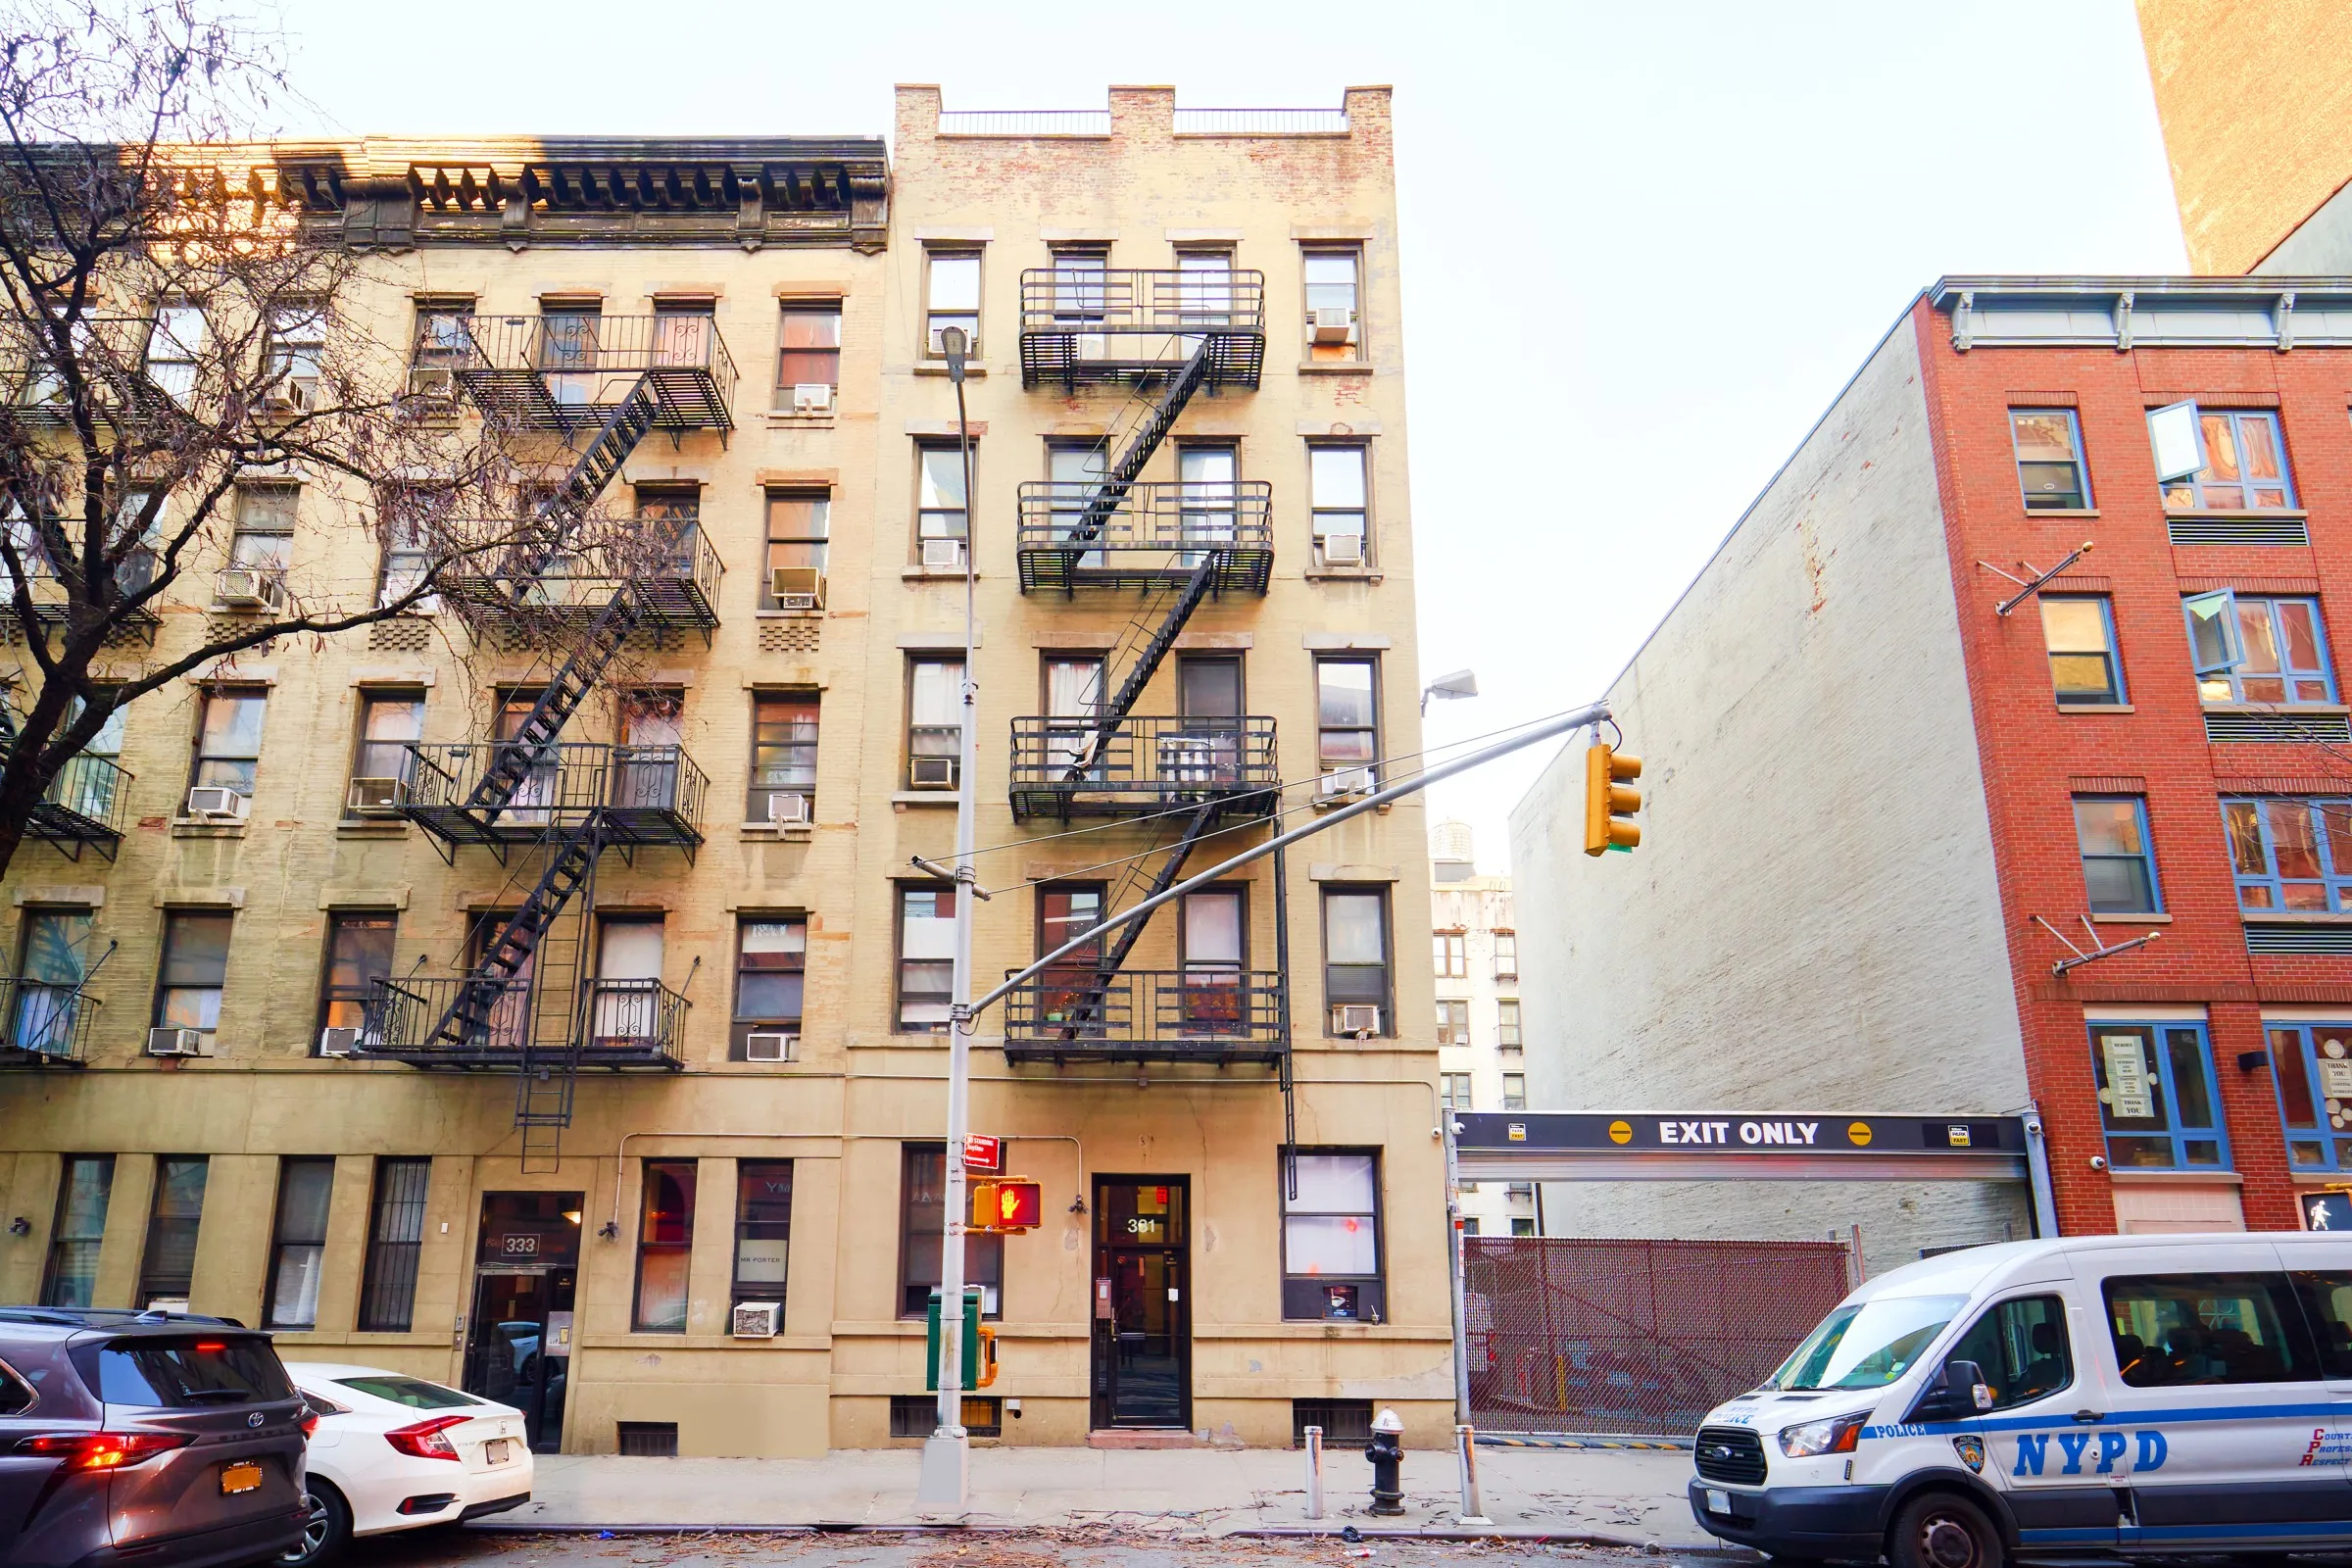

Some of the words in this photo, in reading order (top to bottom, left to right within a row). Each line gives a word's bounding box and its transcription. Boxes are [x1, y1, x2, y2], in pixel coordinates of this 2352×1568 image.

[1658, 1121, 1730, 1144] EXIT
[1739, 1121, 1819, 1145] ONLY
[506, 1238, 536, 1252] 333
[1876, 1423, 1925, 1438] POLICE
[2314, 1428, 2352, 1441] COURT
[2013, 1431, 2168, 1476] NYPD
[2307, 1441, 2352, 1453] PROFES
[2298, 1454, 2351, 1466] RESPECT
